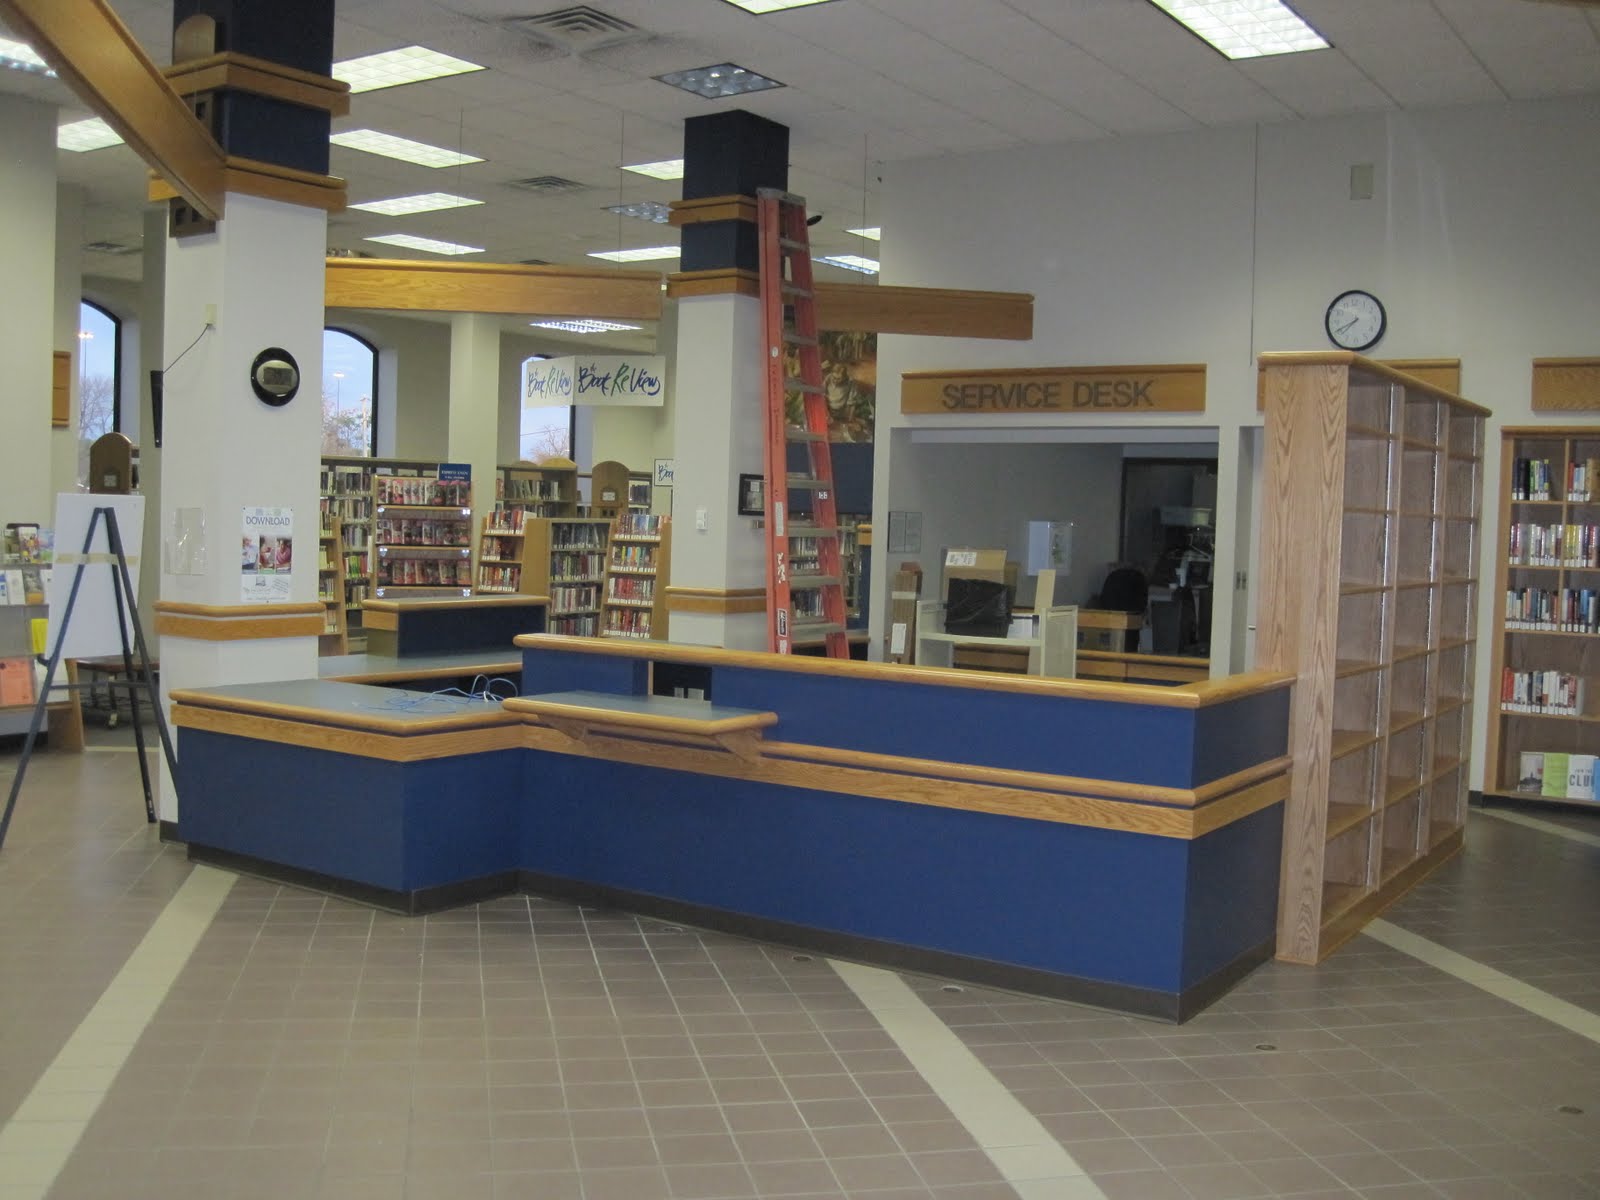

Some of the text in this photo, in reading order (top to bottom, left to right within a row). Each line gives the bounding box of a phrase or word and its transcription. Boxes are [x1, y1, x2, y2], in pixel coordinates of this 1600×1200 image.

[578, 366, 611, 396] Book
[942, 379, 1155, 410] SERVICE DESK
[246, 516, 290, 526] DOWNLOAD
